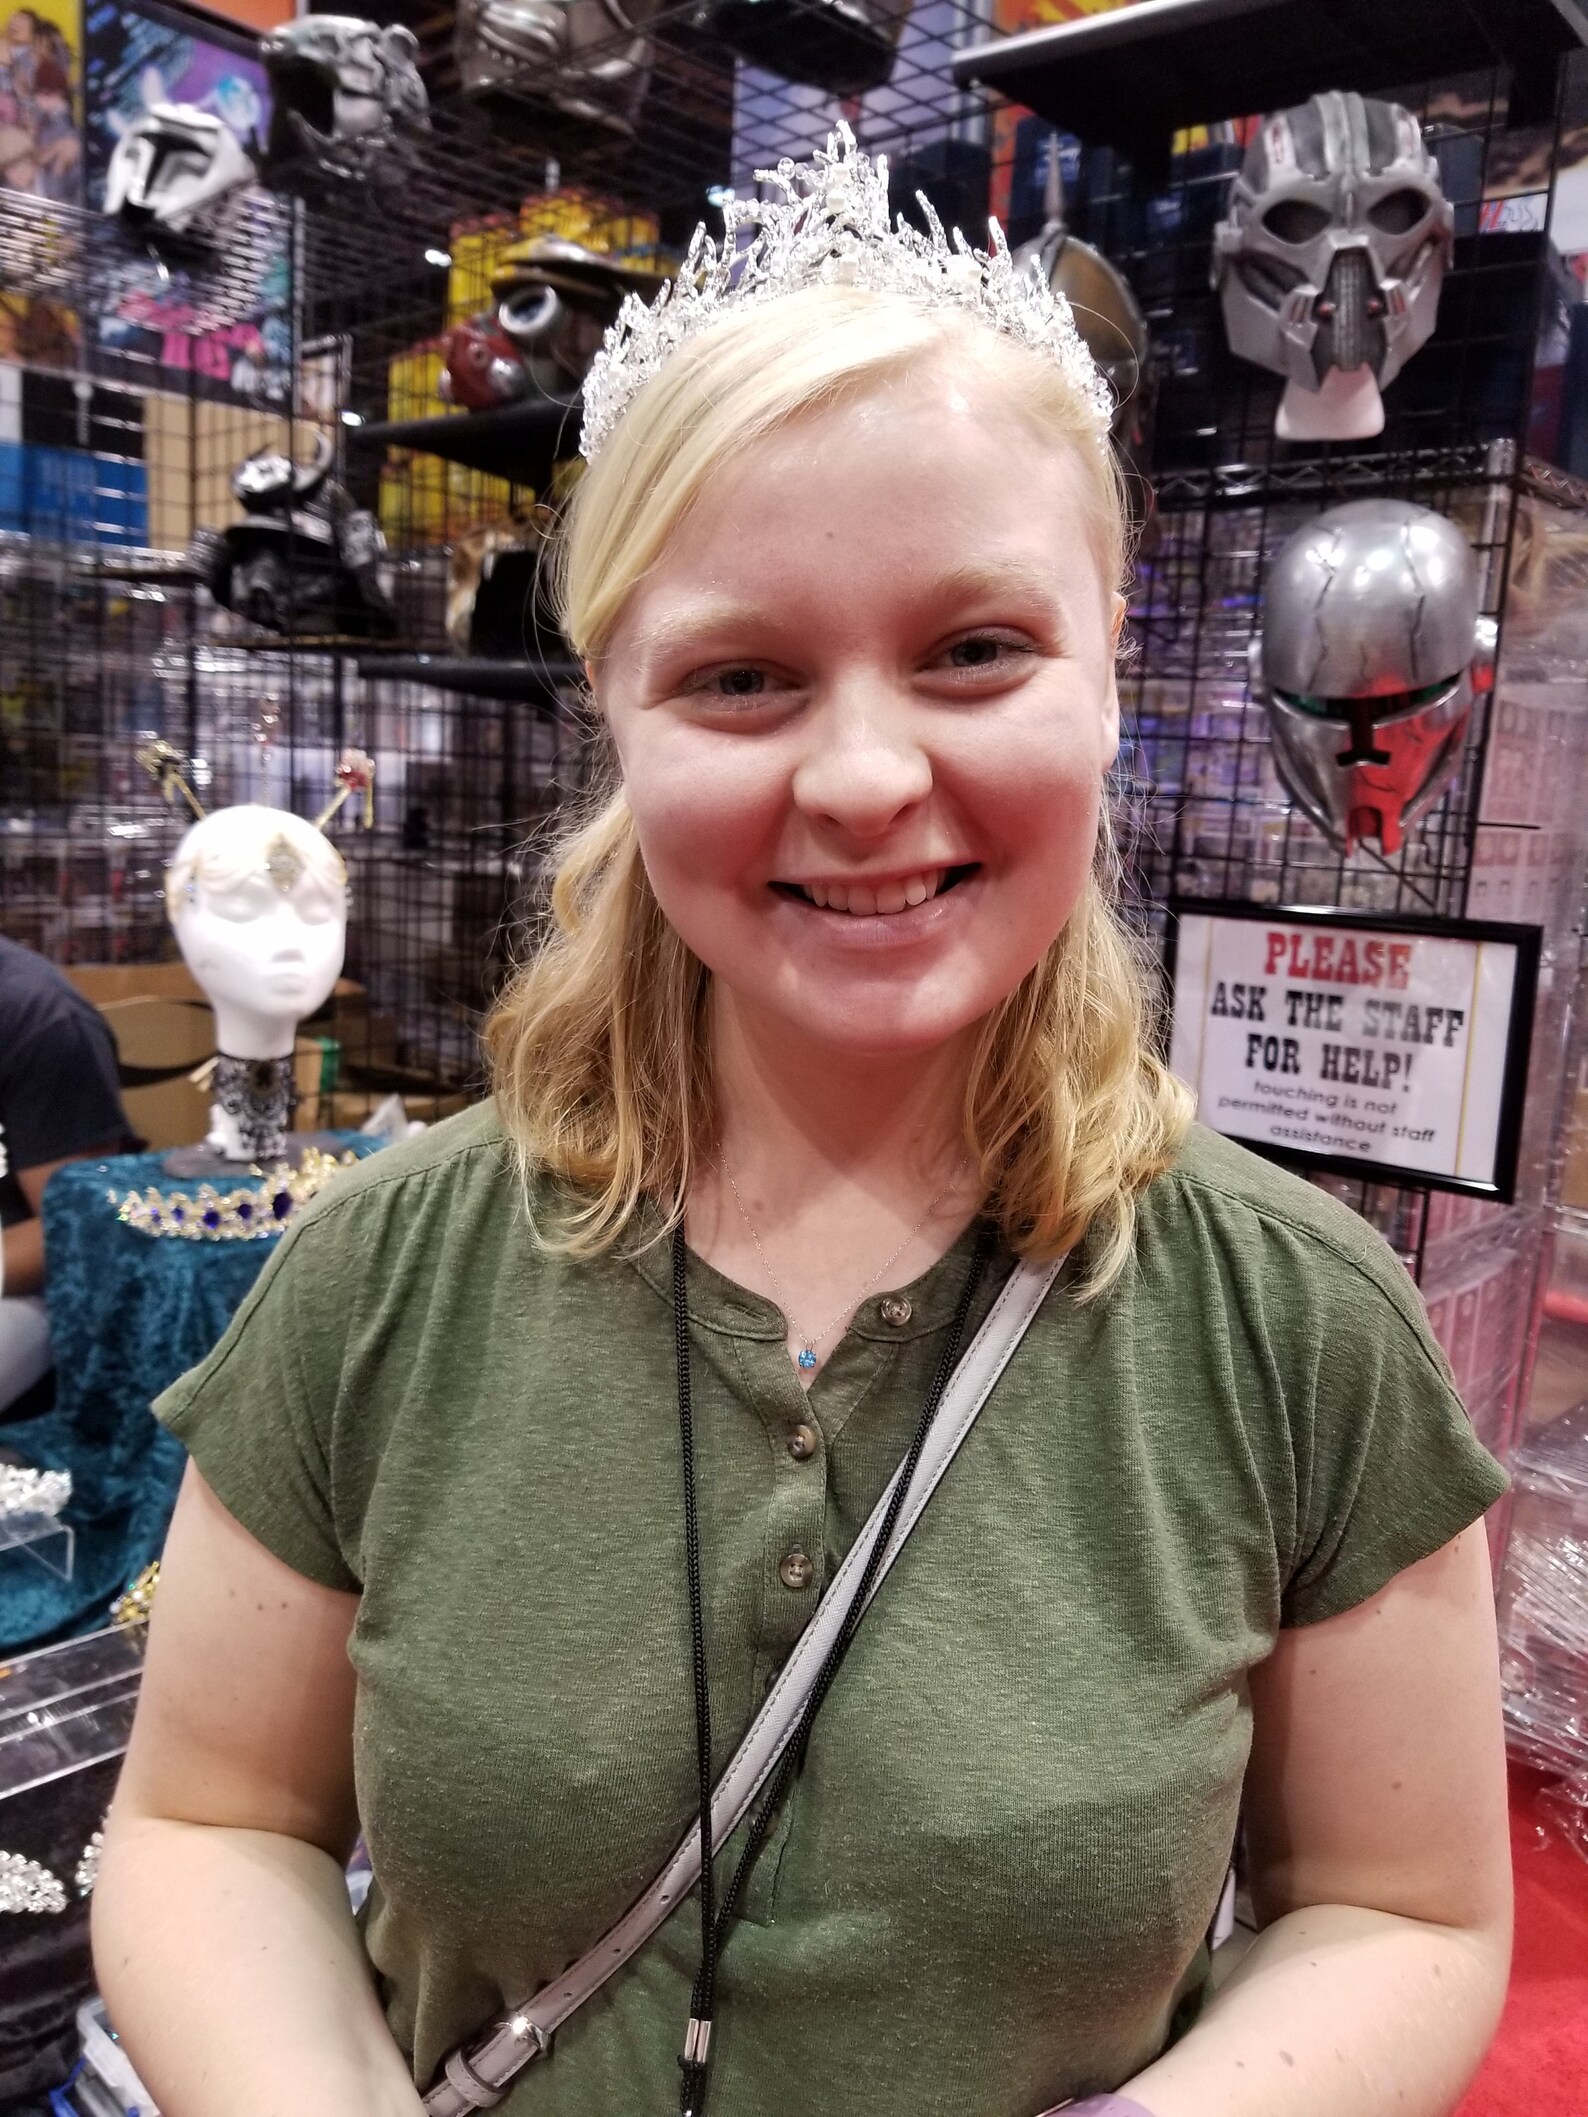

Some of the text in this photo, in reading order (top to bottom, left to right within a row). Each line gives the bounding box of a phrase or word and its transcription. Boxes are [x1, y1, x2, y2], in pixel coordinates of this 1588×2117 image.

[1264, 931, 1411, 990] PLEASE
[1211, 980, 1464, 1047] ASK THE STAFF
[1245, 1033, 1413, 1093] FOR HELP!
[1217, 1095, 1436, 1143] permitted without staff
[1254, 1079, 1398, 1115] touching is not
[1269, 1122, 1373, 1153] assistance
